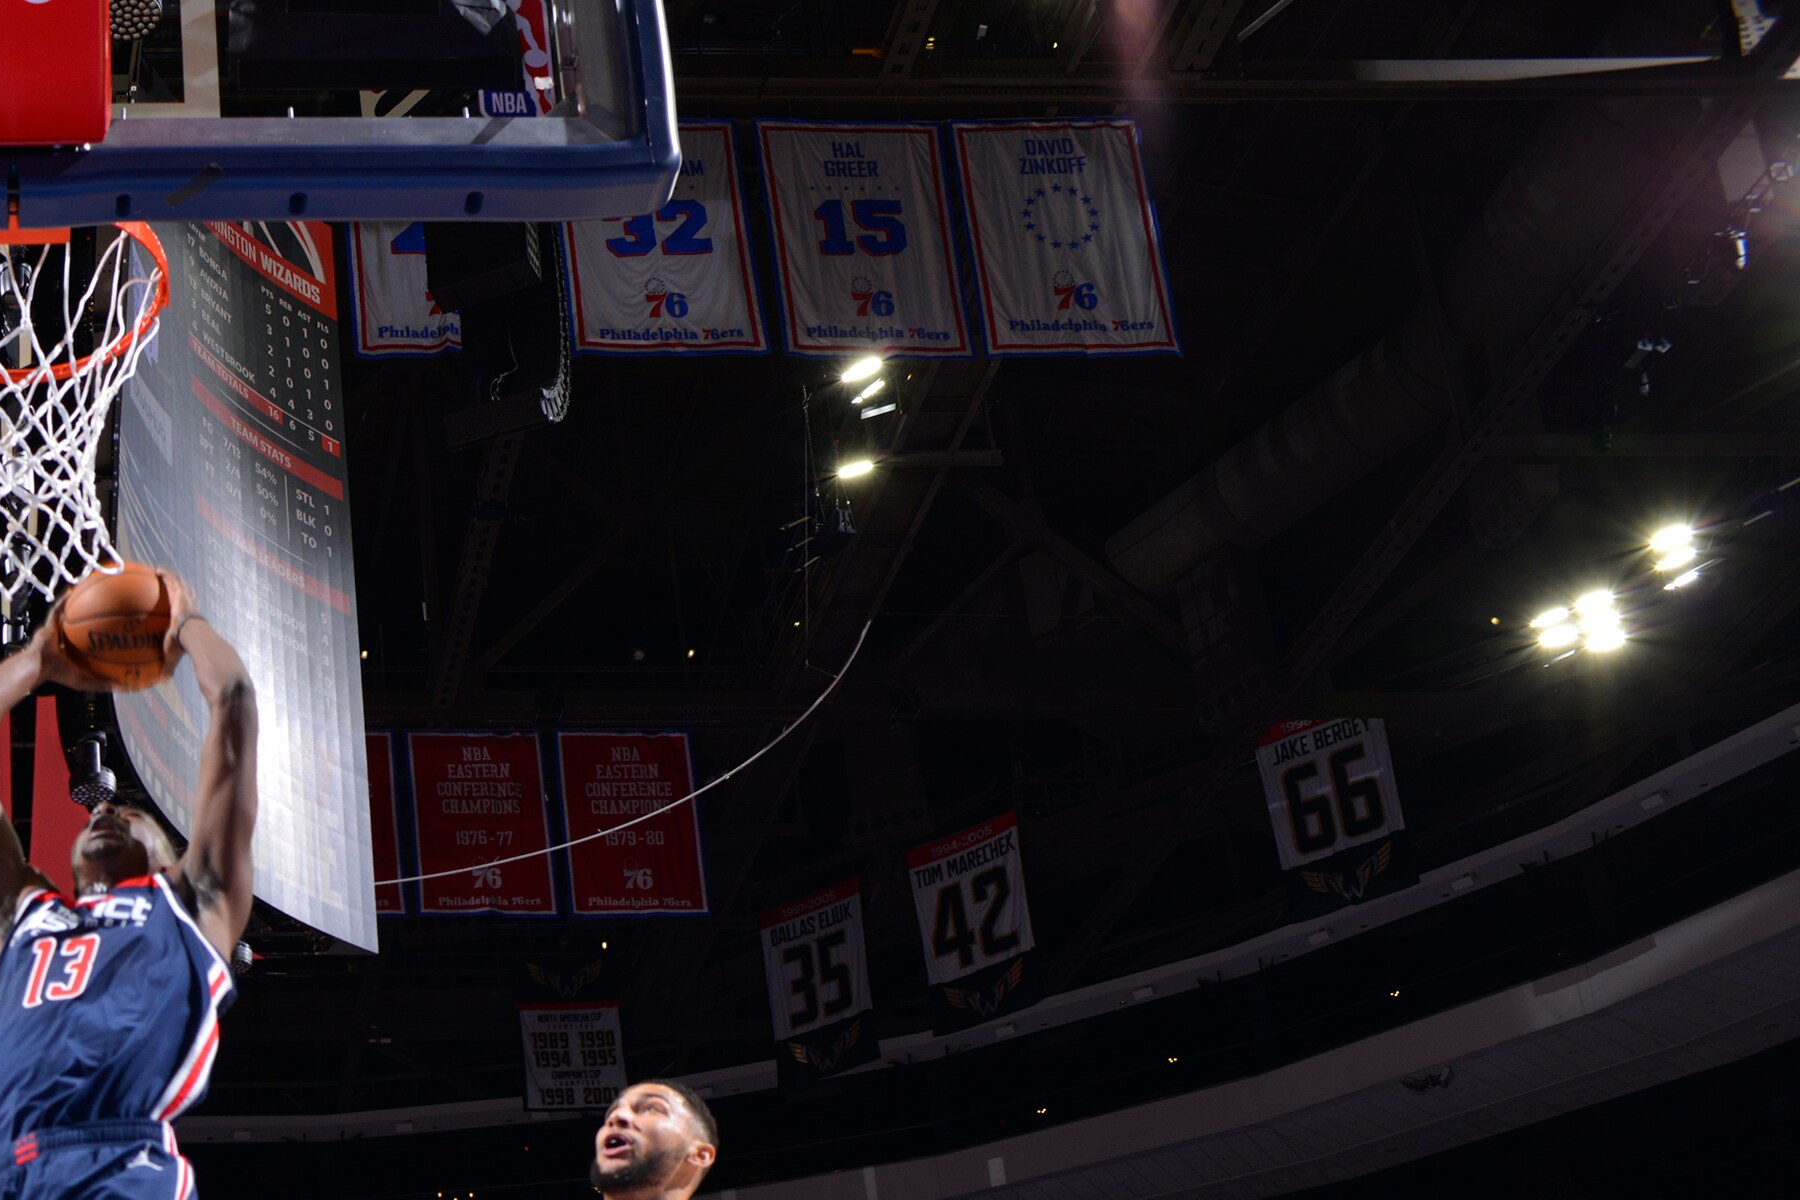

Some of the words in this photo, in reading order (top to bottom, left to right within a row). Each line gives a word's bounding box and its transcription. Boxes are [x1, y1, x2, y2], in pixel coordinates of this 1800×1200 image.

[491, 92, 527, 114] NBA
[832, 141, 865, 159] HAL
[1024, 138, 1074, 156] DAVID
[824, 160, 878, 178] GREER
[1018, 156, 1087, 175] ZINKOFF
[602, 199, 714, 257] 32
[814, 199, 907, 257] 15
[199, 247, 228, 282] BONGA
[200, 268, 229, 302] AVDIJA
[260, 252, 321, 305] WIZARDS
[200, 290, 232, 324] BRYANT
[201, 310, 221, 335] BEAL
[1008, 319, 1107, 334] Philadelphia
[600, 327, 698, 342] Philadelphia
[807, 326, 904, 341] Philadelphia
[202, 331, 256, 384] WESTBROOK
[192, 342, 216, 373] TEAM
[216, 366, 250, 400] TOTALS
[230, 416, 259, 447] TEAM
[260, 439, 292, 469] STATS
[462, 747, 491, 761] NBA
[612, 747, 641, 761] NBA
[1273, 735, 1310, 766] JAKE
[447, 764, 510, 779] EASTERN
[595, 764, 659, 779] EASTERN
[437, 782, 522, 798] CONFERENCE
[585, 782, 672, 798] CONFERENCE
[1280, 741, 1385, 856] 66
[441, 799, 521, 815] CHAMPIONS
[591, 799, 671, 815] CHAMPIONS
[455, 830, 513, 846] 1976-77
[605, 830, 664, 846] 1979-80
[914, 866, 943, 889] TOM
[946, 832, 1015, 878] MARECHEK
[932, 864, 1021, 970] 42
[770, 916, 816, 947] DALLAS
[21, 932, 101, 1008] 13
[781, 929, 853, 1032] 35
[530, 1032, 569, 1050] 1989
[578, 1030, 615, 1048] 1990
[533, 1050, 571, 1068] 1994
[580, 1048, 617, 1067] 1995
[539, 1088, 575, 1105] 1998
